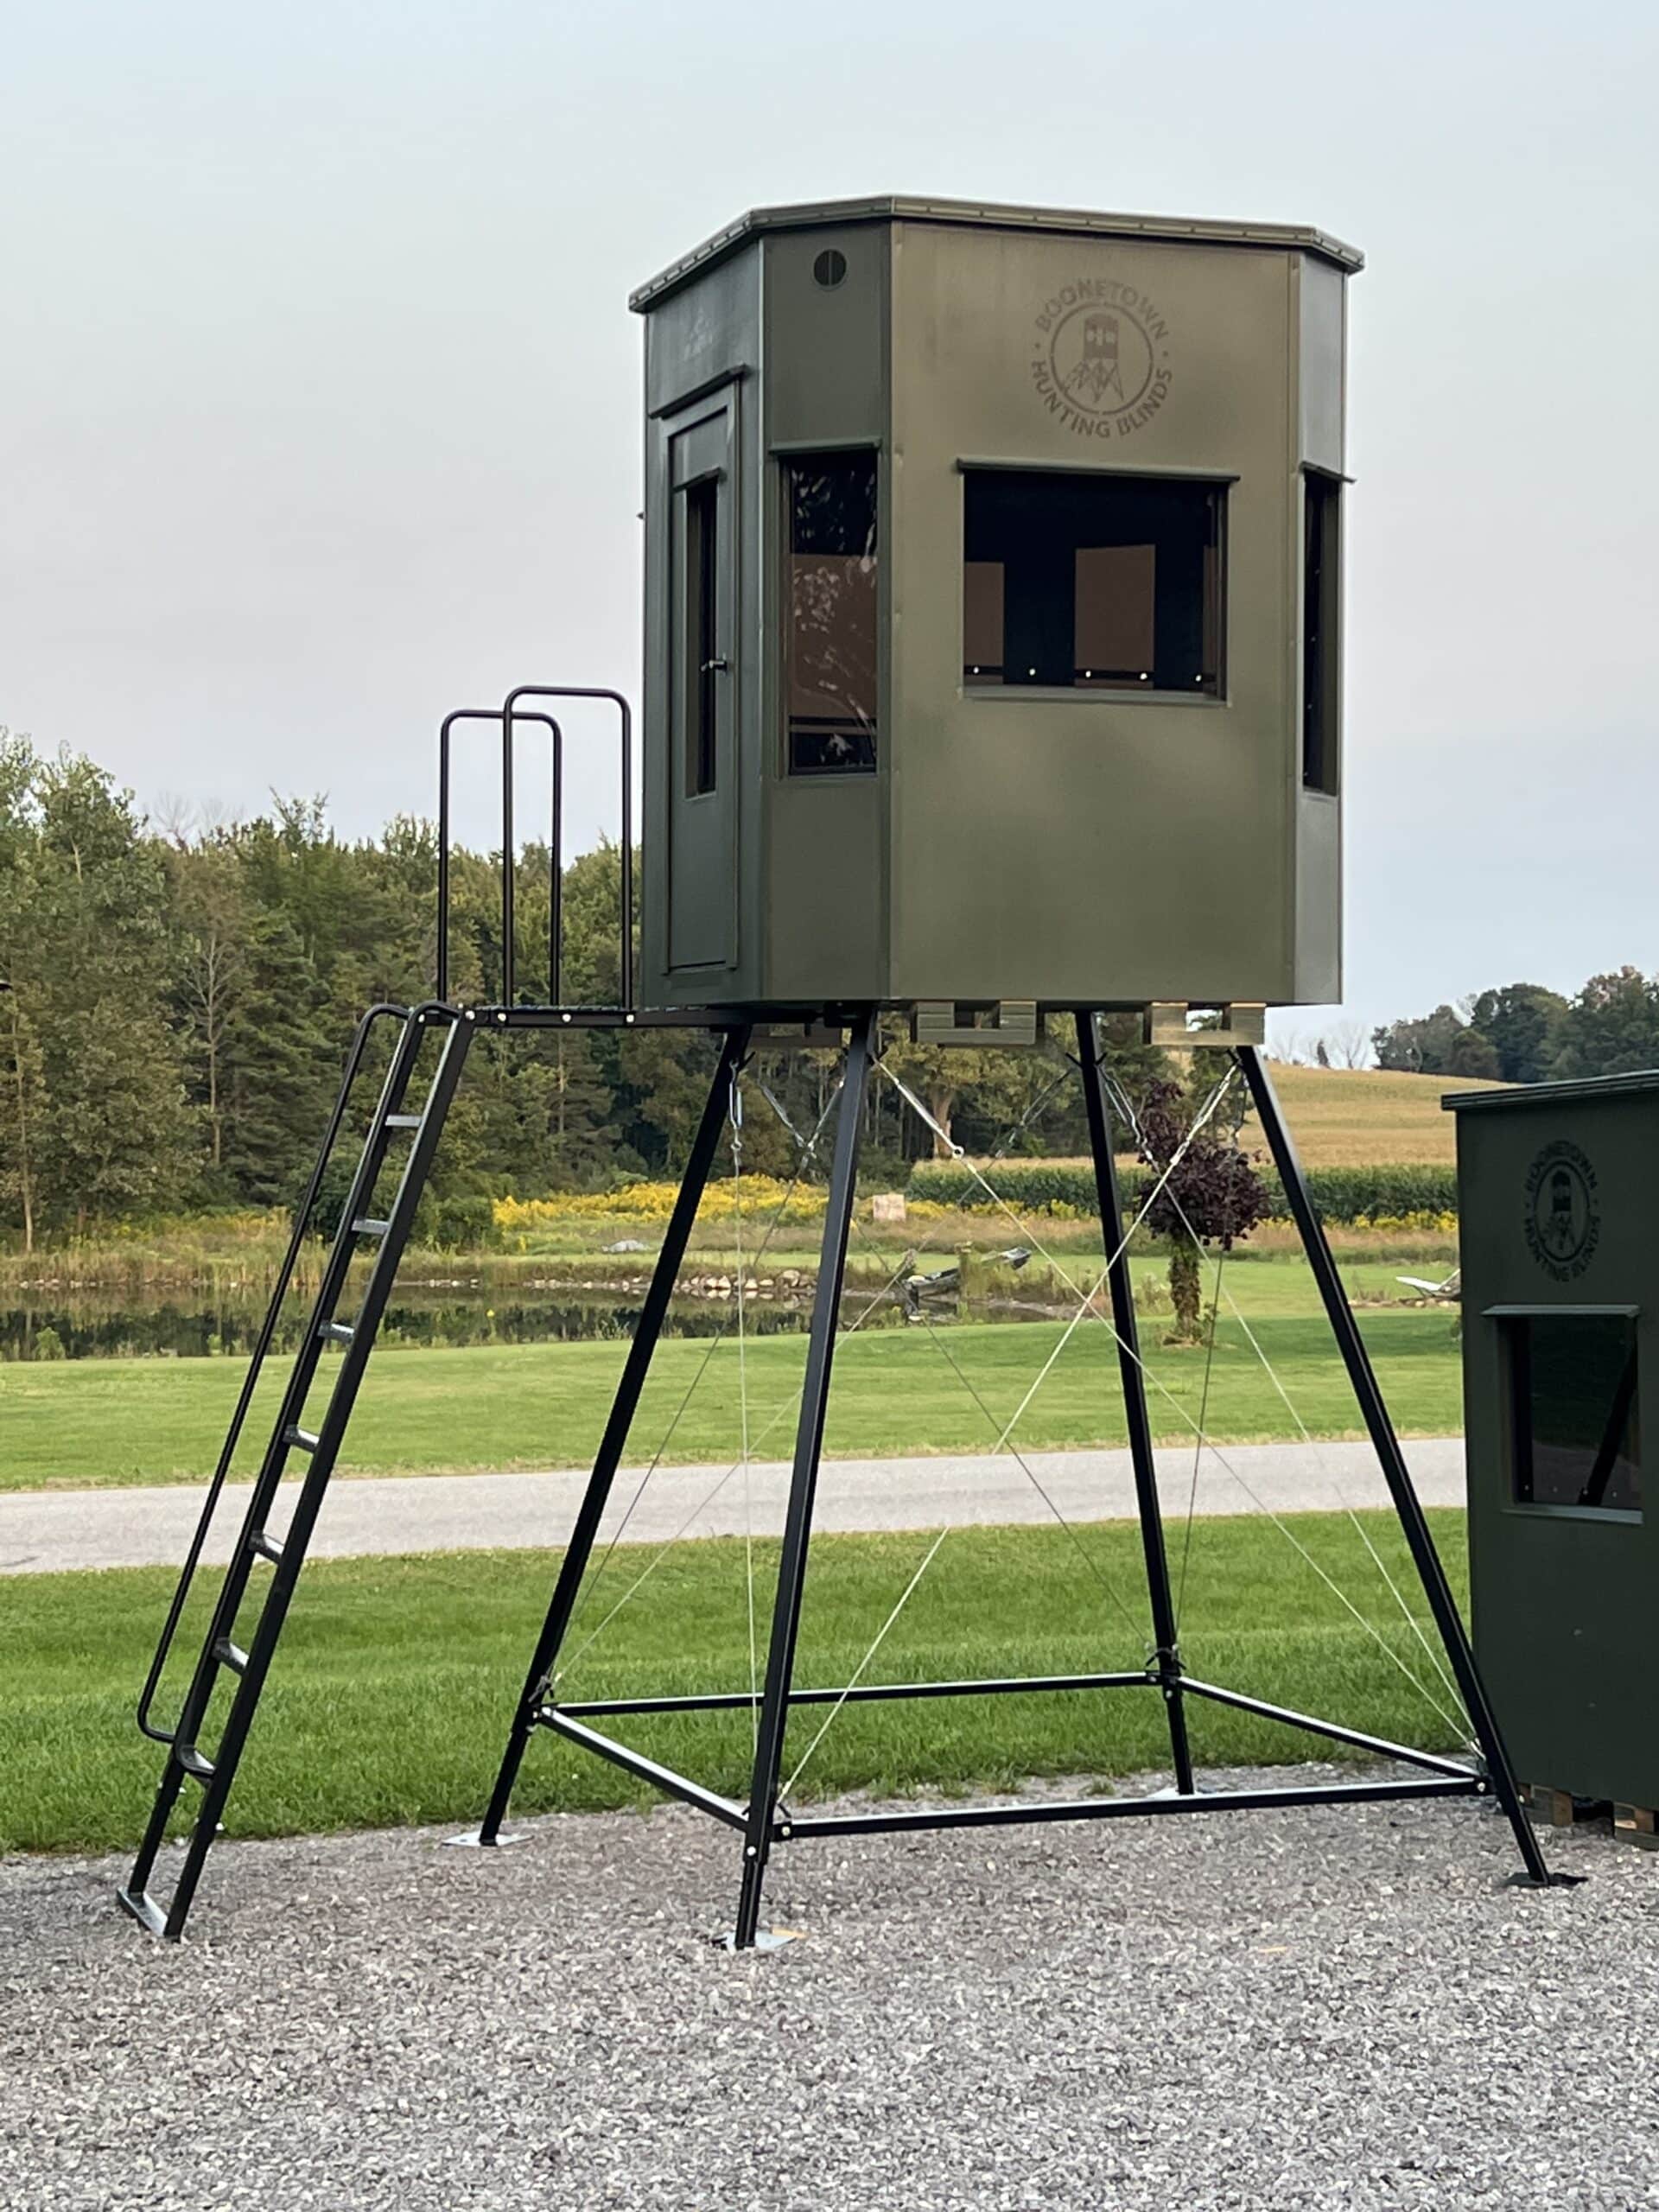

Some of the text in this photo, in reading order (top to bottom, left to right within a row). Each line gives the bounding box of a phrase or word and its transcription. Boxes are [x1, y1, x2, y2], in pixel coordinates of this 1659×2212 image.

[1035, 278, 1169, 340] BOONETOWN
[1032, 359, 1173, 438] HUNTING BLINDS
